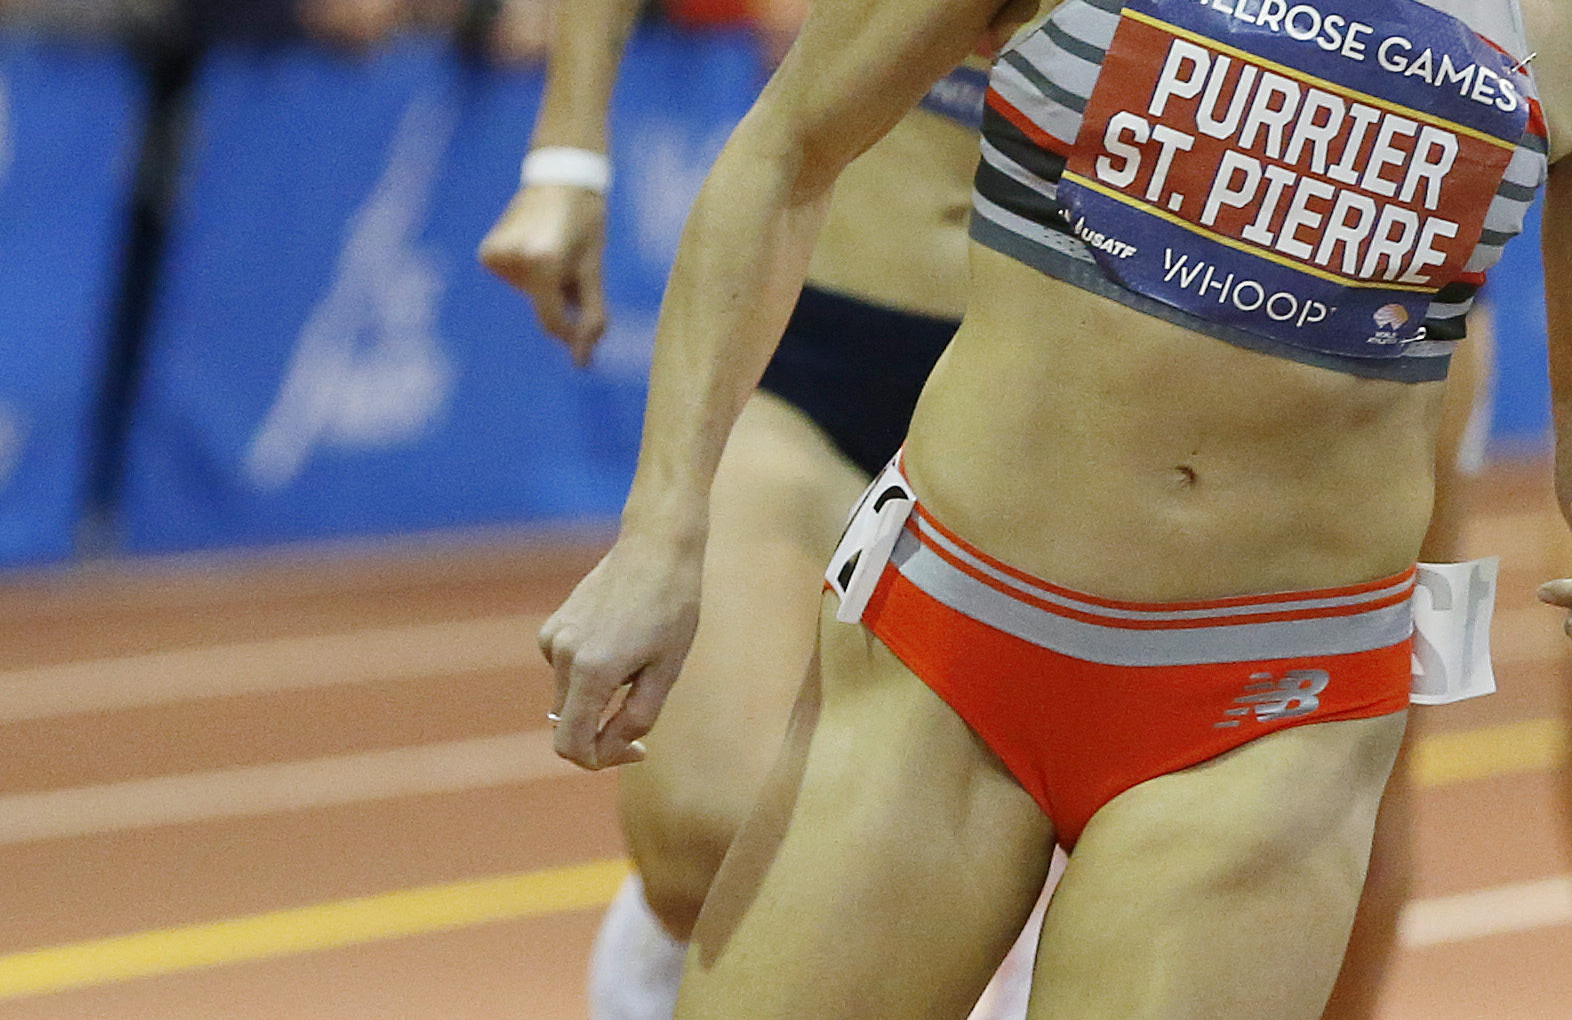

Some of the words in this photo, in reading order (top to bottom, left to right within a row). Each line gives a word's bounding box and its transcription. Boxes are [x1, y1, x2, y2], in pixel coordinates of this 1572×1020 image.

[1377, 37, 1518, 112] GAMES
[1149, 38, 1459, 211] PURRIER
[1095, 111, 1196, 212] ST.
[1200, 149, 1459, 285] PIERRE
[1081, 227, 1138, 259] USATF
[1164, 247, 1328, 328] WHOOP
